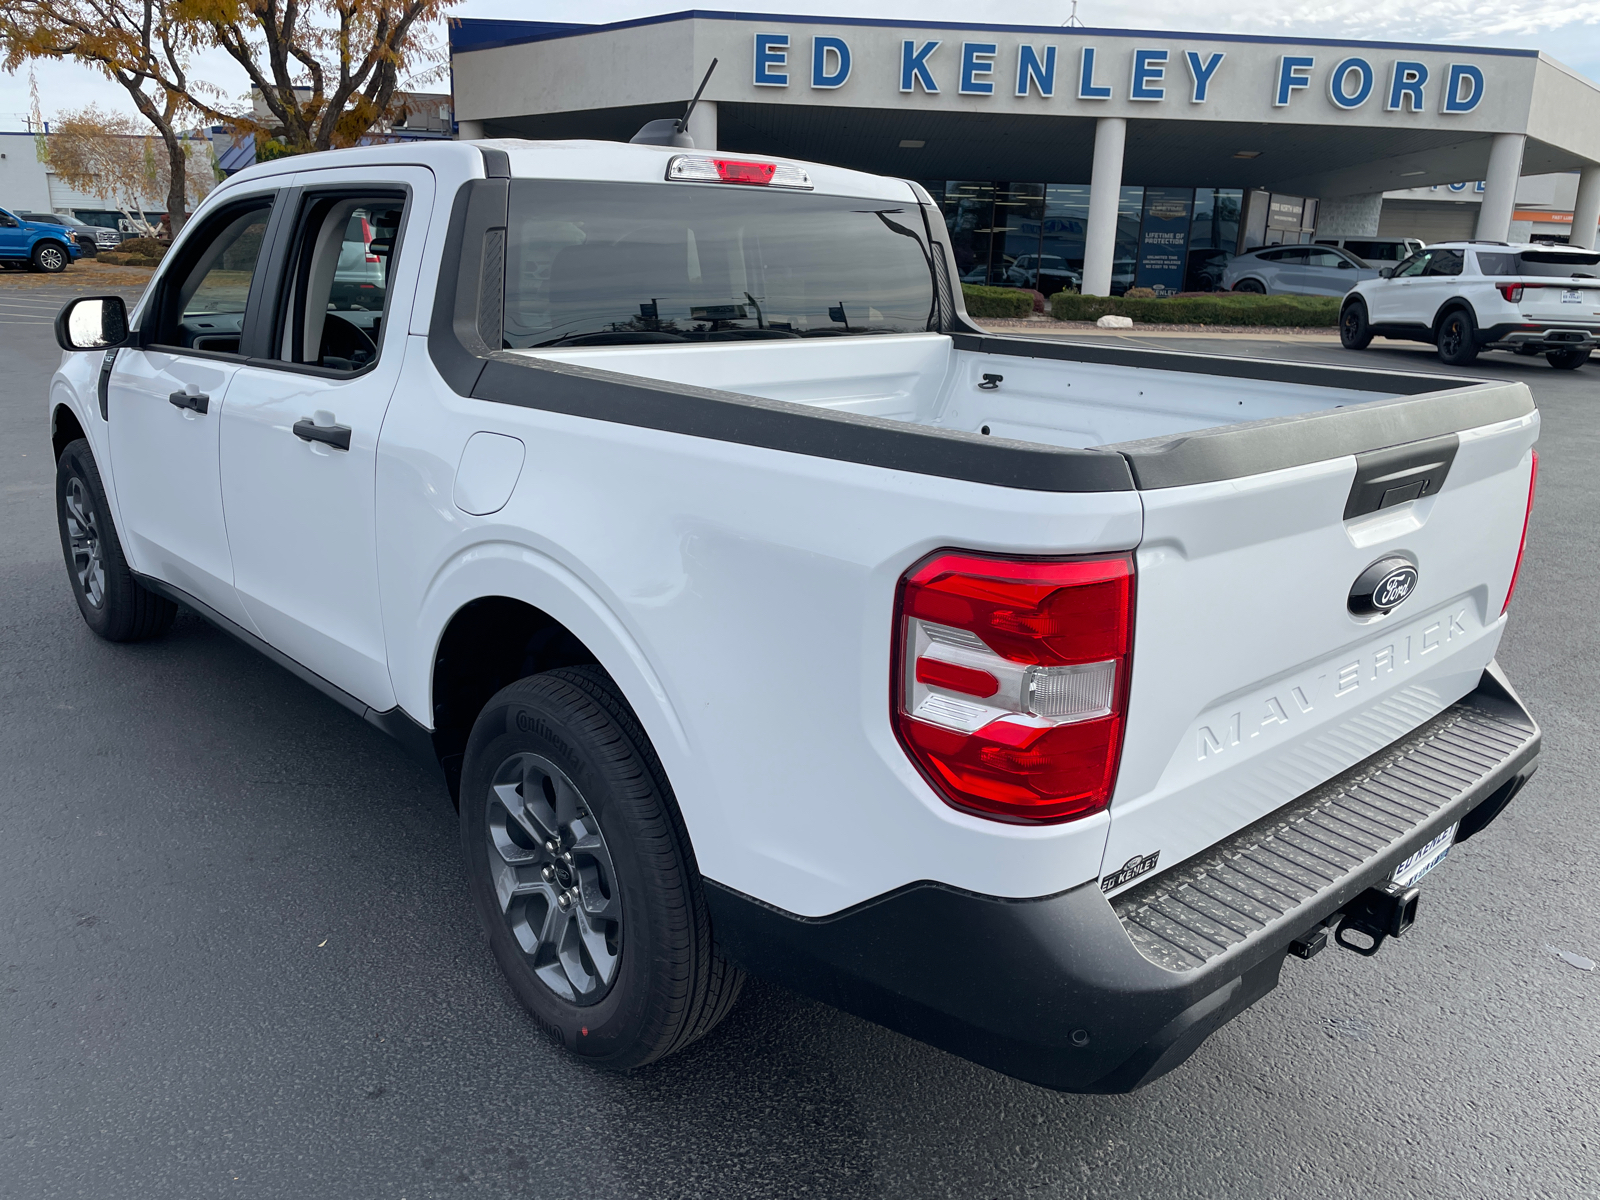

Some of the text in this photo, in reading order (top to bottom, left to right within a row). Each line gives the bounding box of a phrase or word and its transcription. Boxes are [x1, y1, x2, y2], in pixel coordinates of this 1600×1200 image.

[753, 32, 1486, 114] ED KENLEY FORD
[1381, 574, 1411, 604] Ford
[1197, 608, 1466, 762] MAVERICK
[516, 709, 587, 775] Continental
[1101, 880, 1115, 891] ED
[1118, 855, 1159, 884] KENLEY
